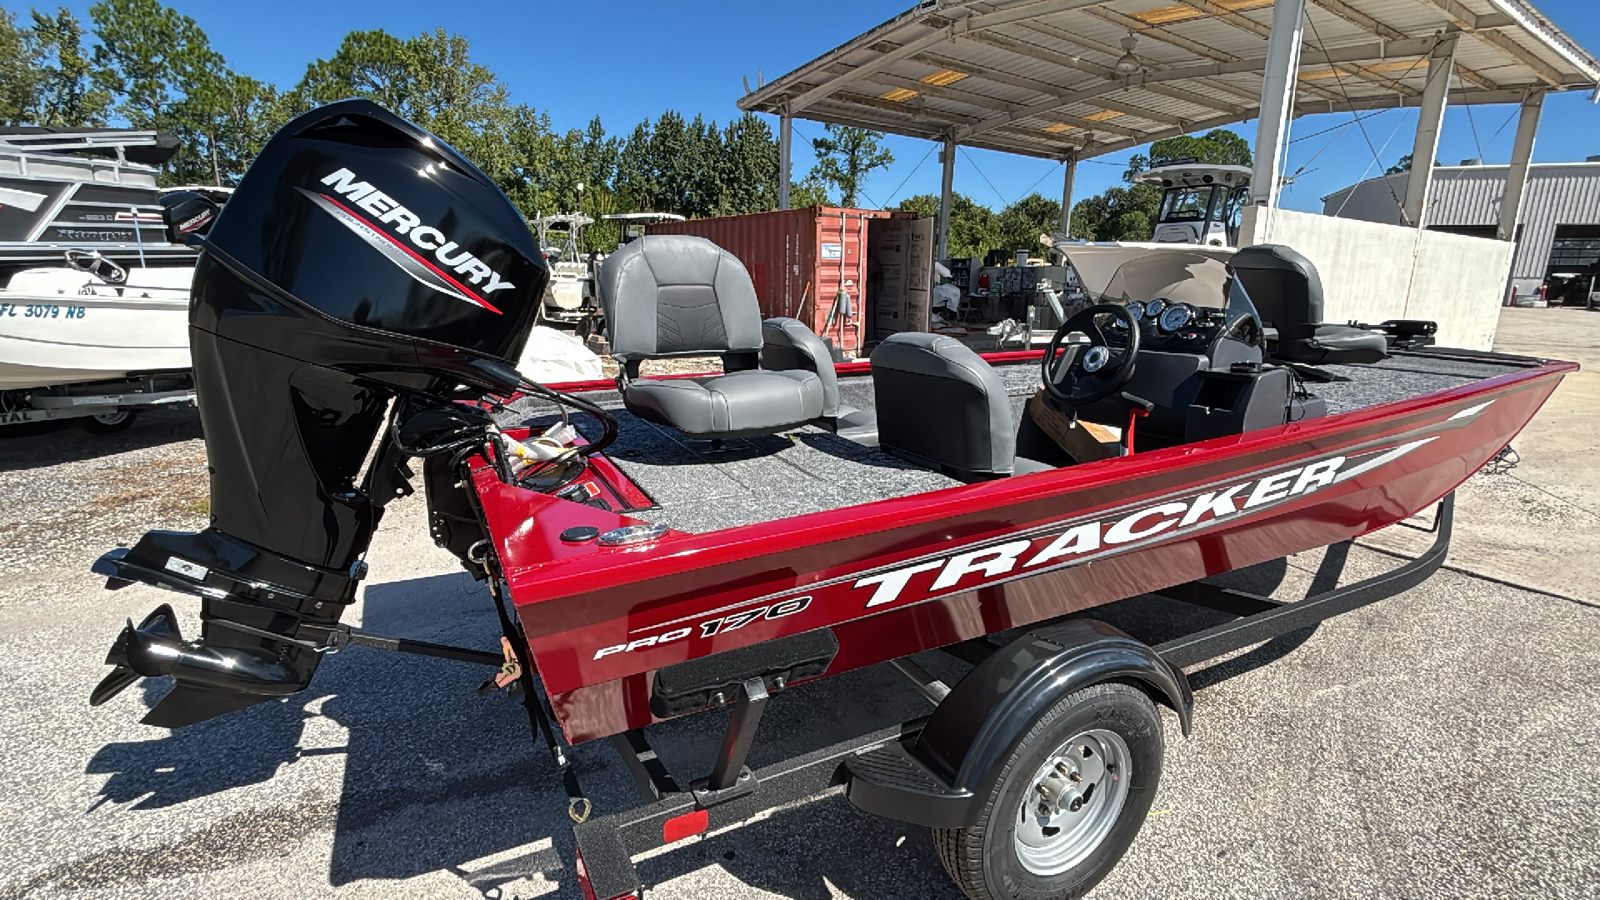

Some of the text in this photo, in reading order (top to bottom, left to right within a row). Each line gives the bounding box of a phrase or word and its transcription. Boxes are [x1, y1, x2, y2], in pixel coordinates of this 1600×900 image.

[179, 208, 211, 231] MERCURY
[320, 167, 516, 294] MERCURY
[0, 303, 86, 319] FL 3079 NB
[852, 455, 1348, 608] TRACKER
[593, 595, 813, 661] PRO 170
